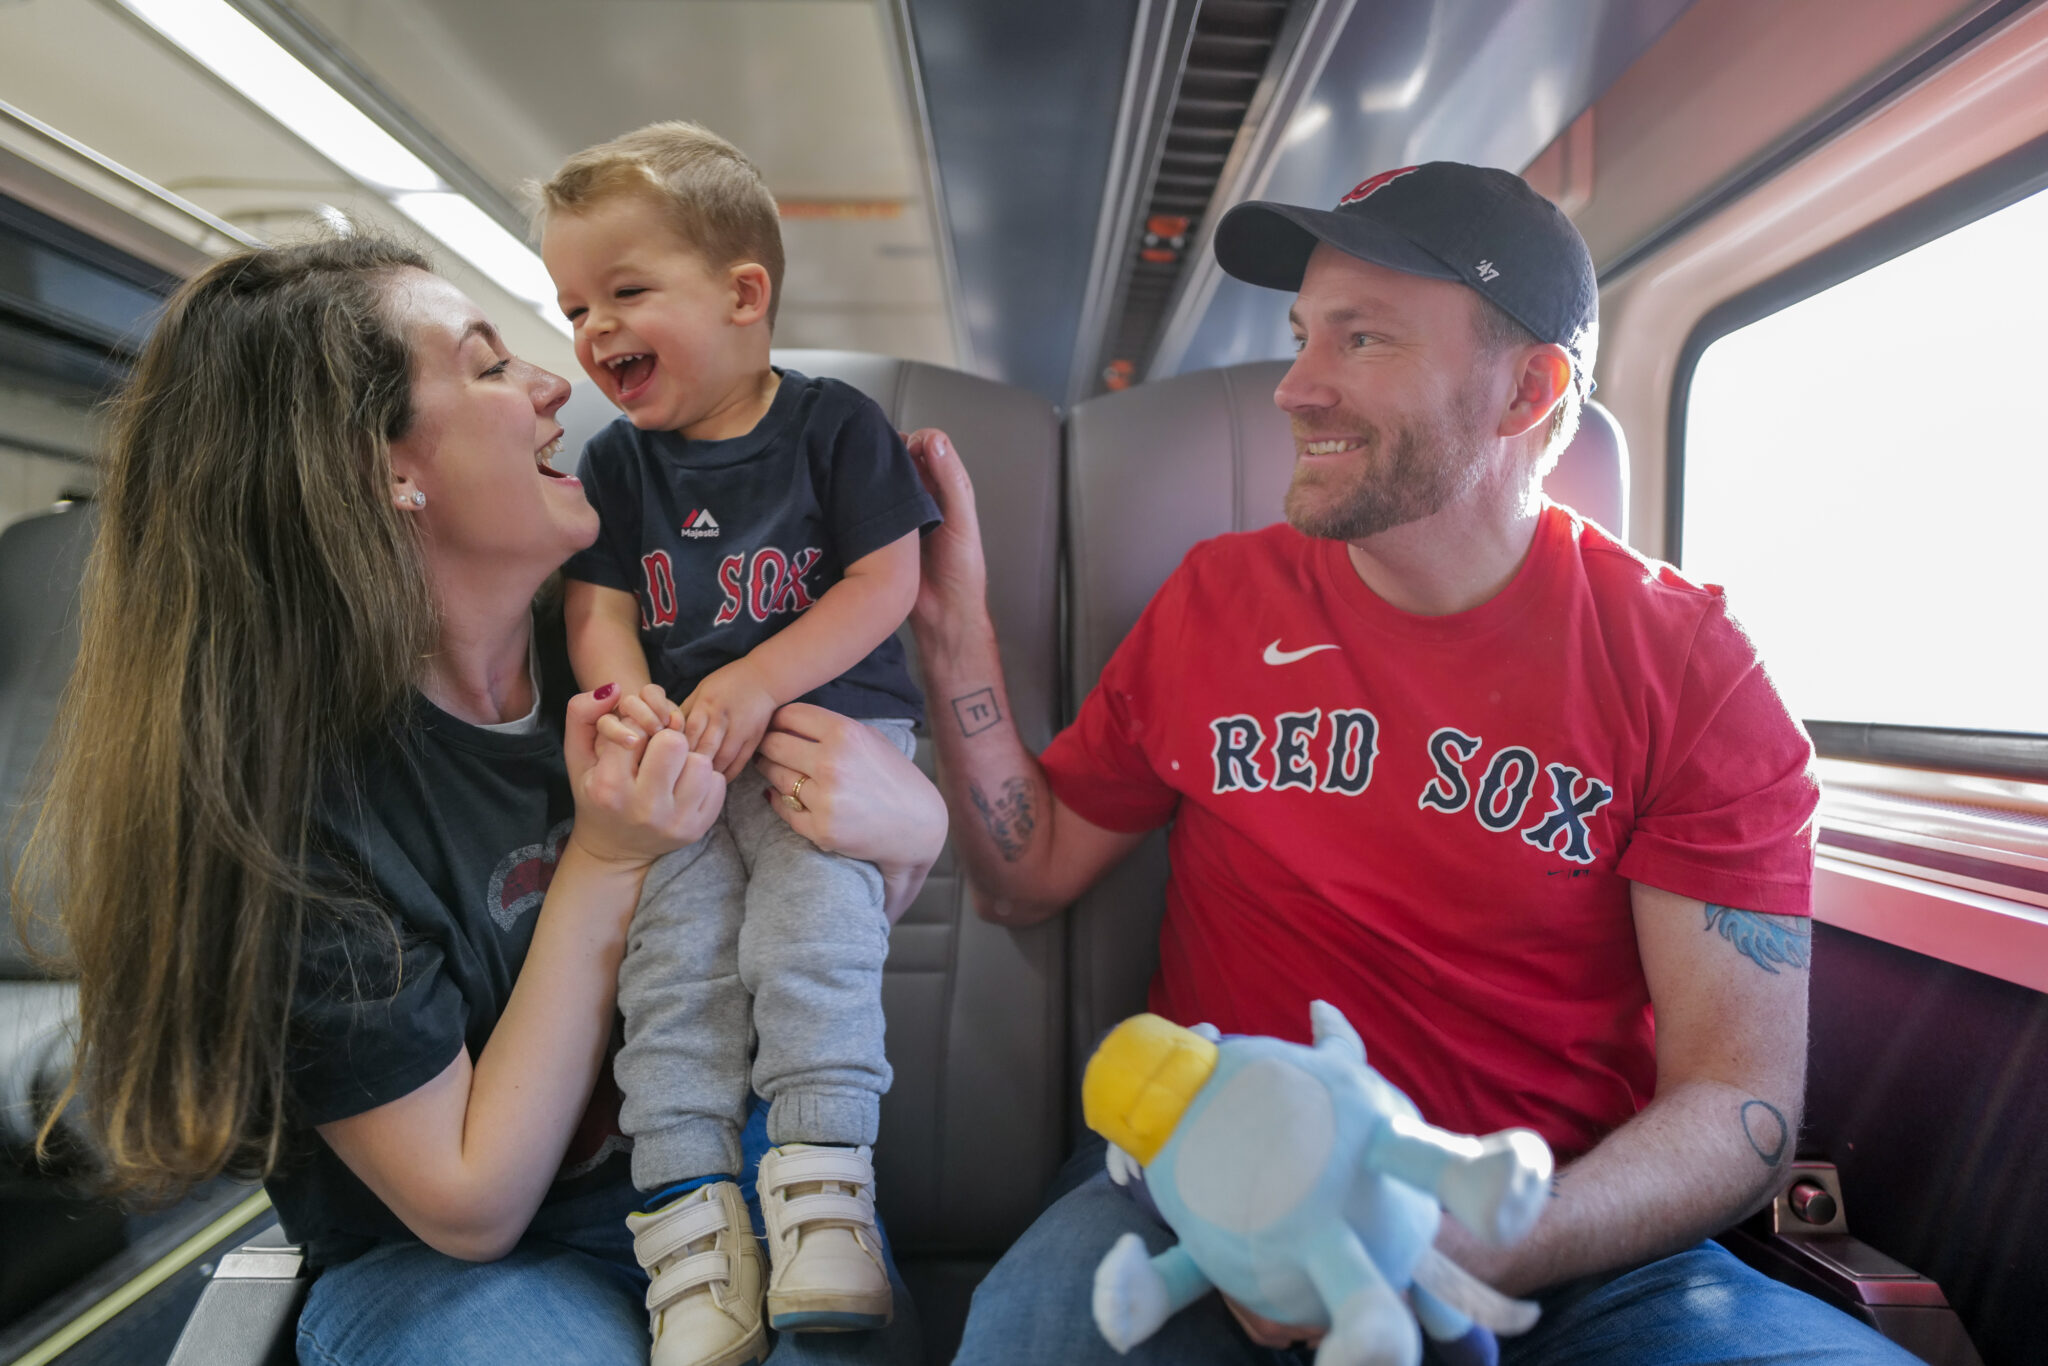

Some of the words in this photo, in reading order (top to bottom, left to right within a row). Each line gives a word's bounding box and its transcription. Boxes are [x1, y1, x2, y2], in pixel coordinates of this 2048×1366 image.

[680, 528, 720, 539] Majestic
[713, 547, 822, 626] SOX
[1209, 707, 1380, 796] RED
[1418, 727, 1613, 865] SOX
